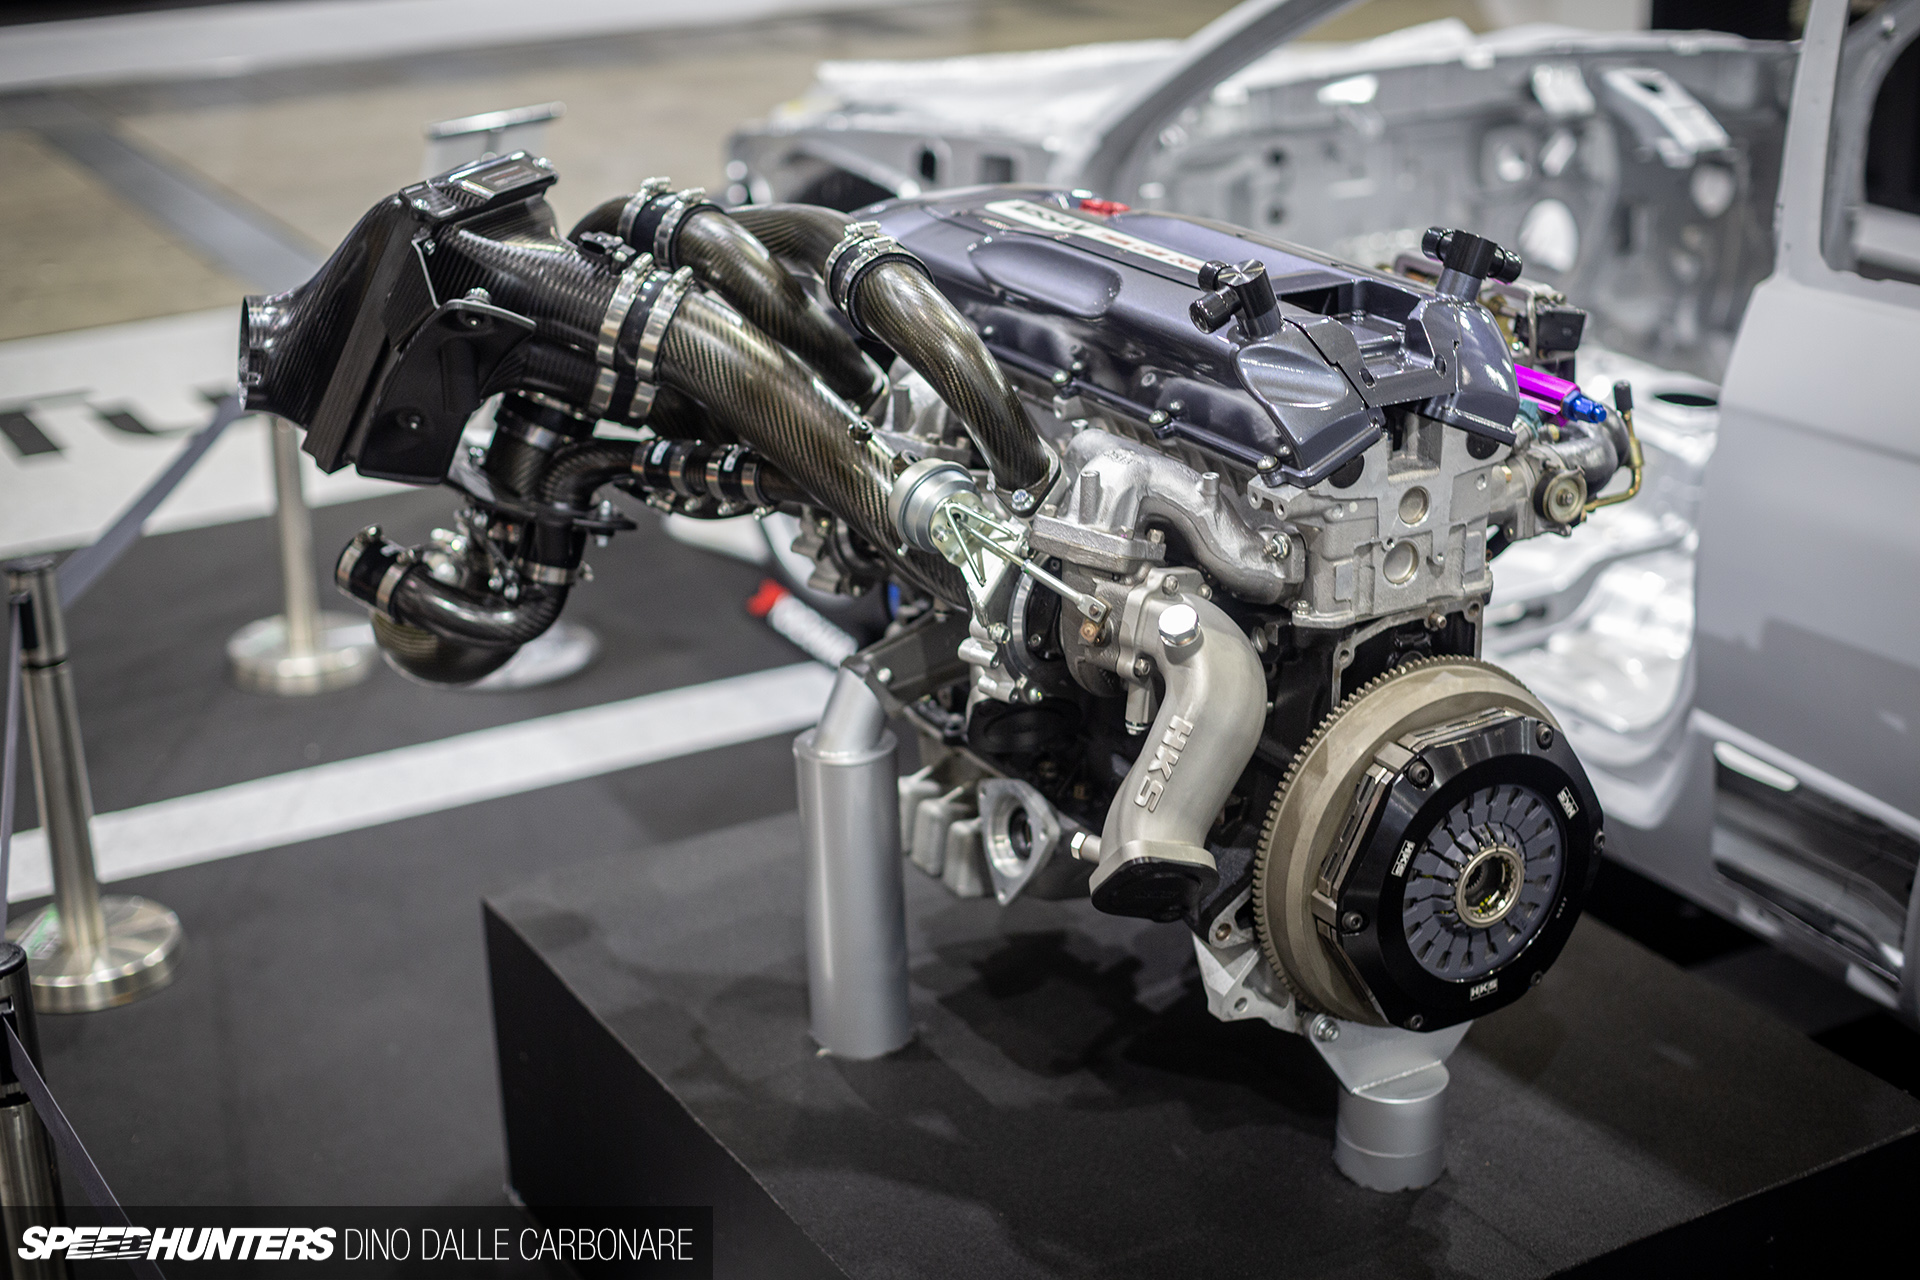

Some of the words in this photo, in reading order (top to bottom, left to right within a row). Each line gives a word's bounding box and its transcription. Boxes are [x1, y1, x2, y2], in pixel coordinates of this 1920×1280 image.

[1134, 715, 1194, 813] HKS
[1391, 840, 1415, 877] HKS
[1470, 978, 1498, 1001] HKS
